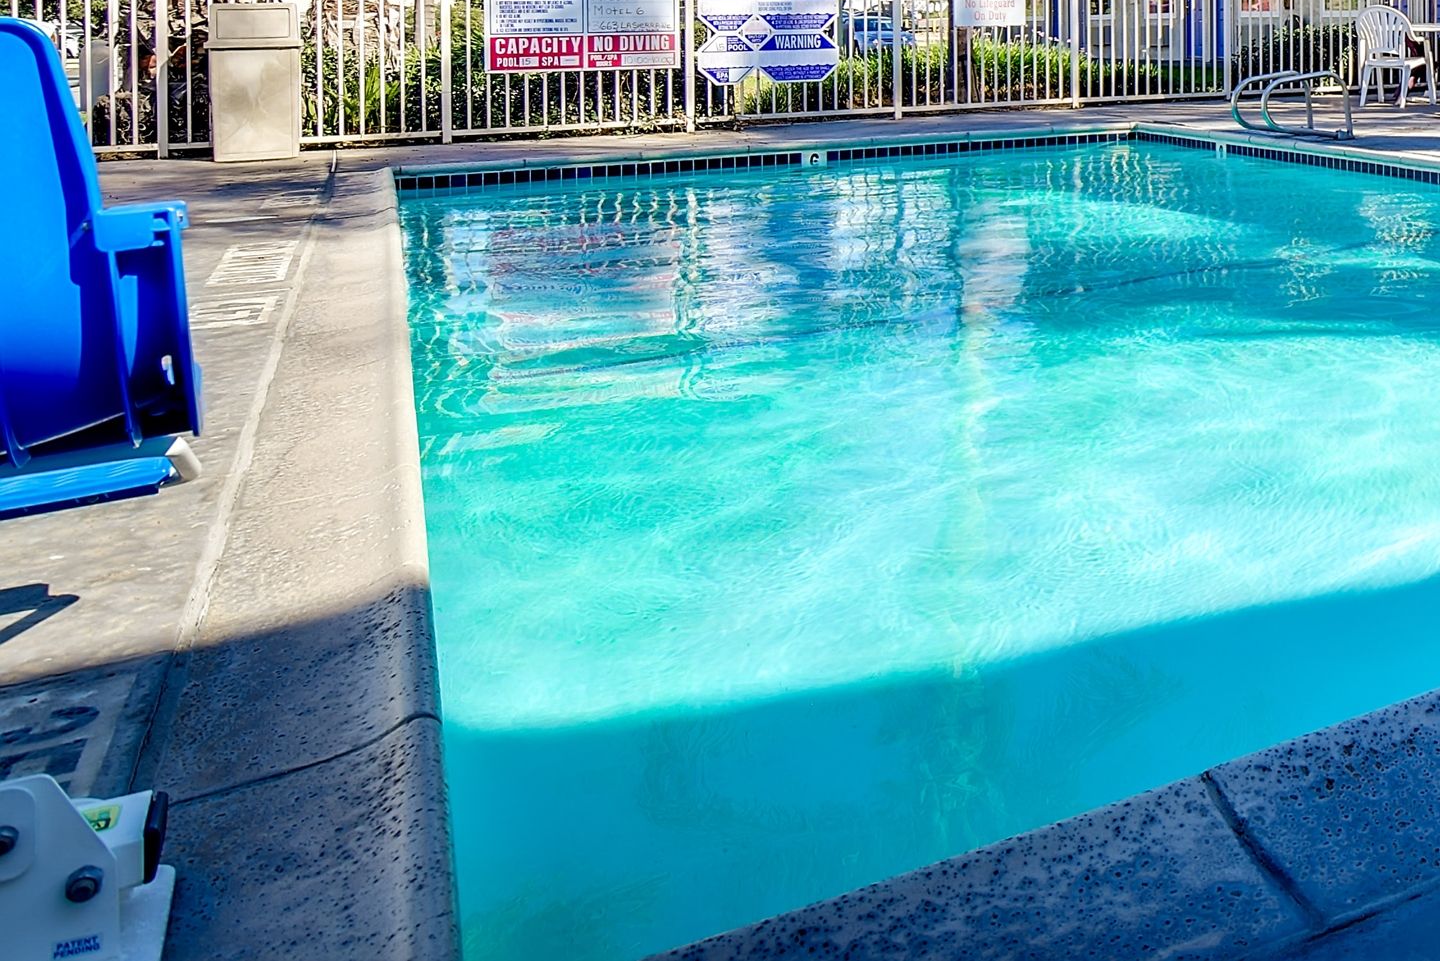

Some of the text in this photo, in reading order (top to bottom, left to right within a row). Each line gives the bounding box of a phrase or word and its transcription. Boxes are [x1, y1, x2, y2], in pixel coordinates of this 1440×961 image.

[974, 11, 1007, 22] On Duty
[495, 37, 582, 55] CAPACITY
[593, 35, 670, 52] NO DIVING
[774, 35, 822, 49] WARNING
[496, 57, 519, 67] POOL
[541, 56, 559, 66] SPA
[53, 942, 101, 959] PENDING
[56, 935, 98, 951] PATENT
